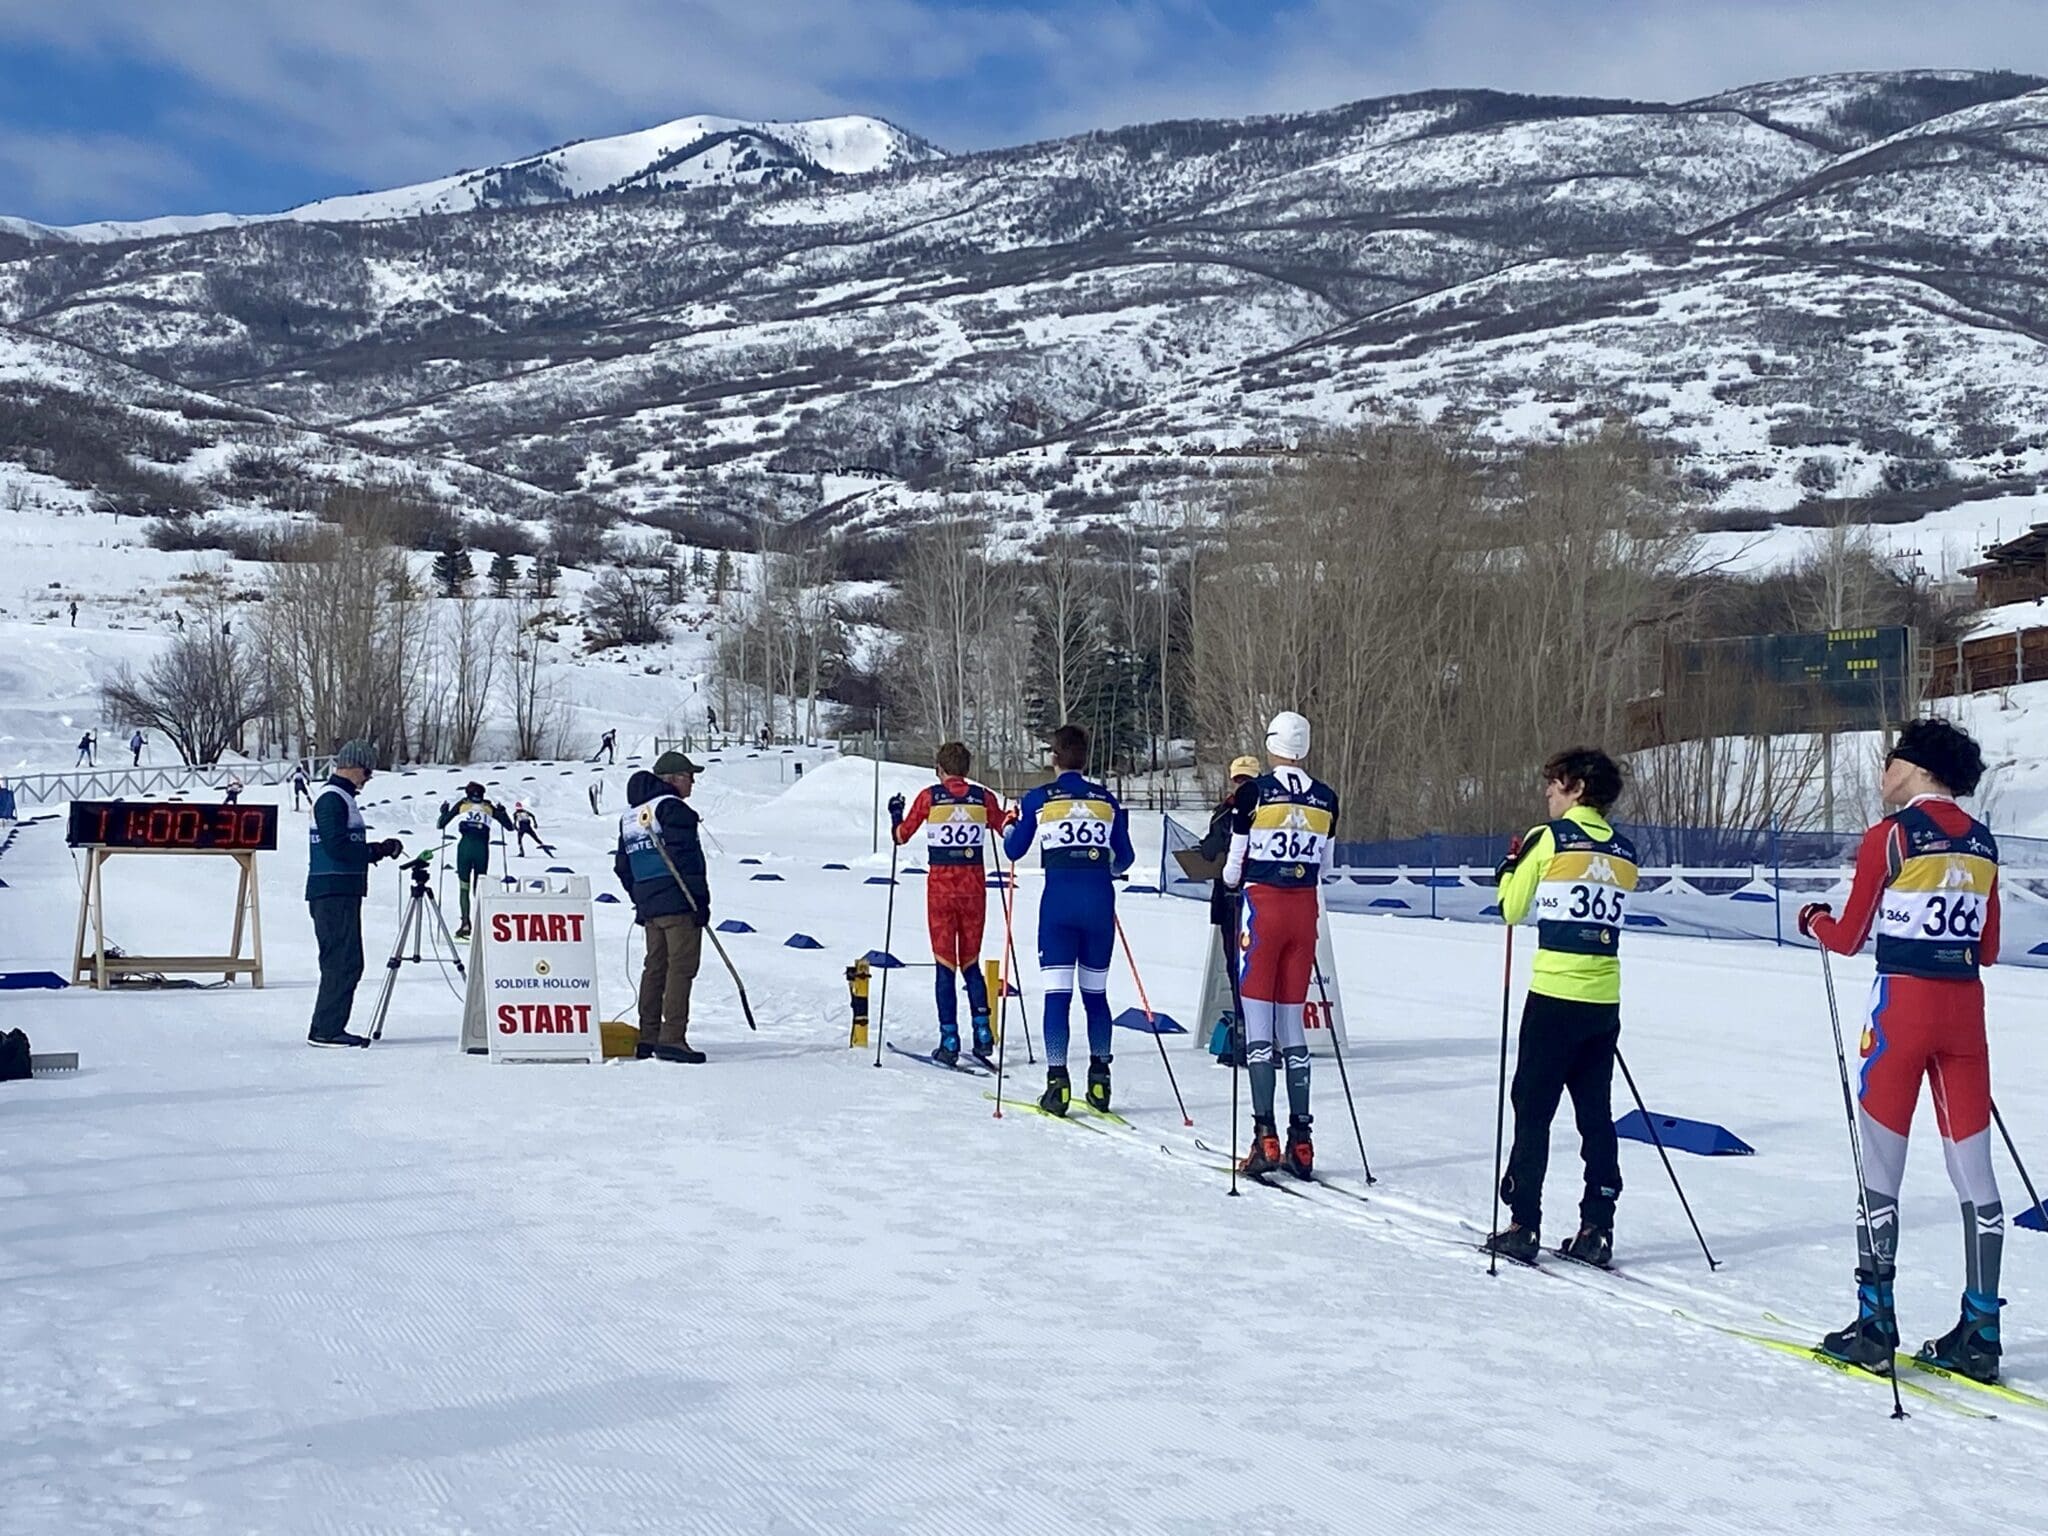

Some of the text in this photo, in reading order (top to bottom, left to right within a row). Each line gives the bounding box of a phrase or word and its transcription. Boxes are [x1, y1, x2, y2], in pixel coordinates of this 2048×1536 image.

[940, 824, 981, 845] 362
[1059, 821, 1106, 845] 363
[1270, 831, 1317, 860] 364
[1568, 885, 1626, 923] 365
[1886, 909, 1911, 923] 366
[1922, 895, 1980, 937] 366
[492, 913, 585, 942] START
[494, 978, 590, 989] SOLDIER HOLLOW
[497, 1004, 592, 1034] START
